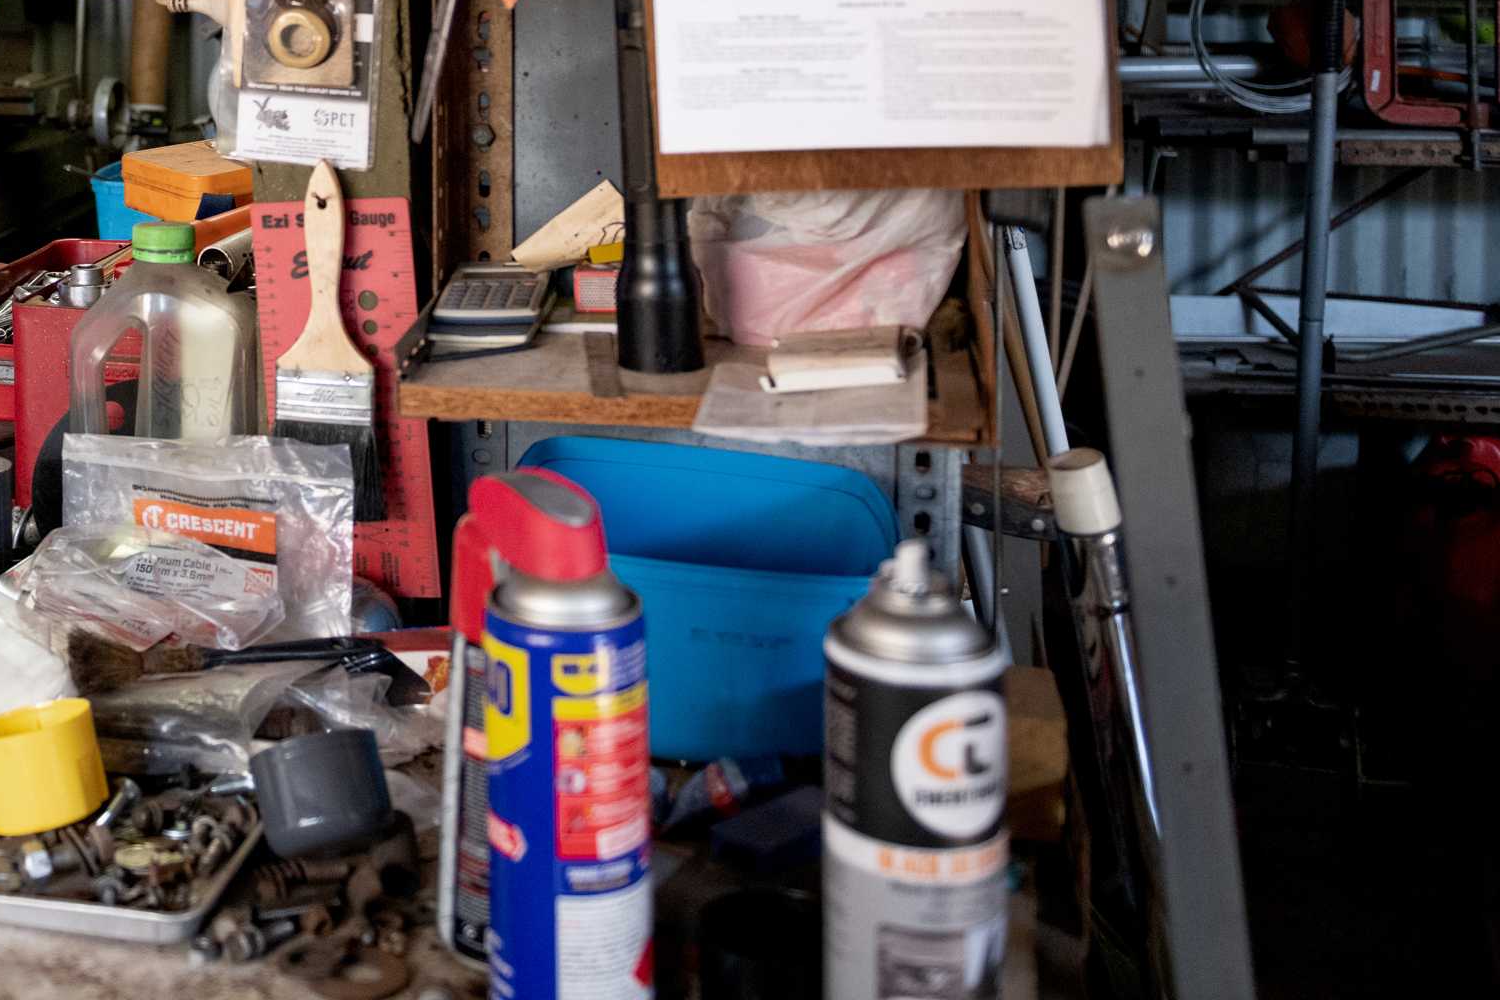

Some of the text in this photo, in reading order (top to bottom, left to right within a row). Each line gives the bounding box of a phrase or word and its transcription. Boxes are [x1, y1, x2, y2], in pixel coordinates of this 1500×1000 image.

[261, 214, 289, 229] Ezi
[350, 210, 396, 227] Gauge
[166, 511, 258, 540] CRESCENT
[183, 559, 211, 571] Cable
